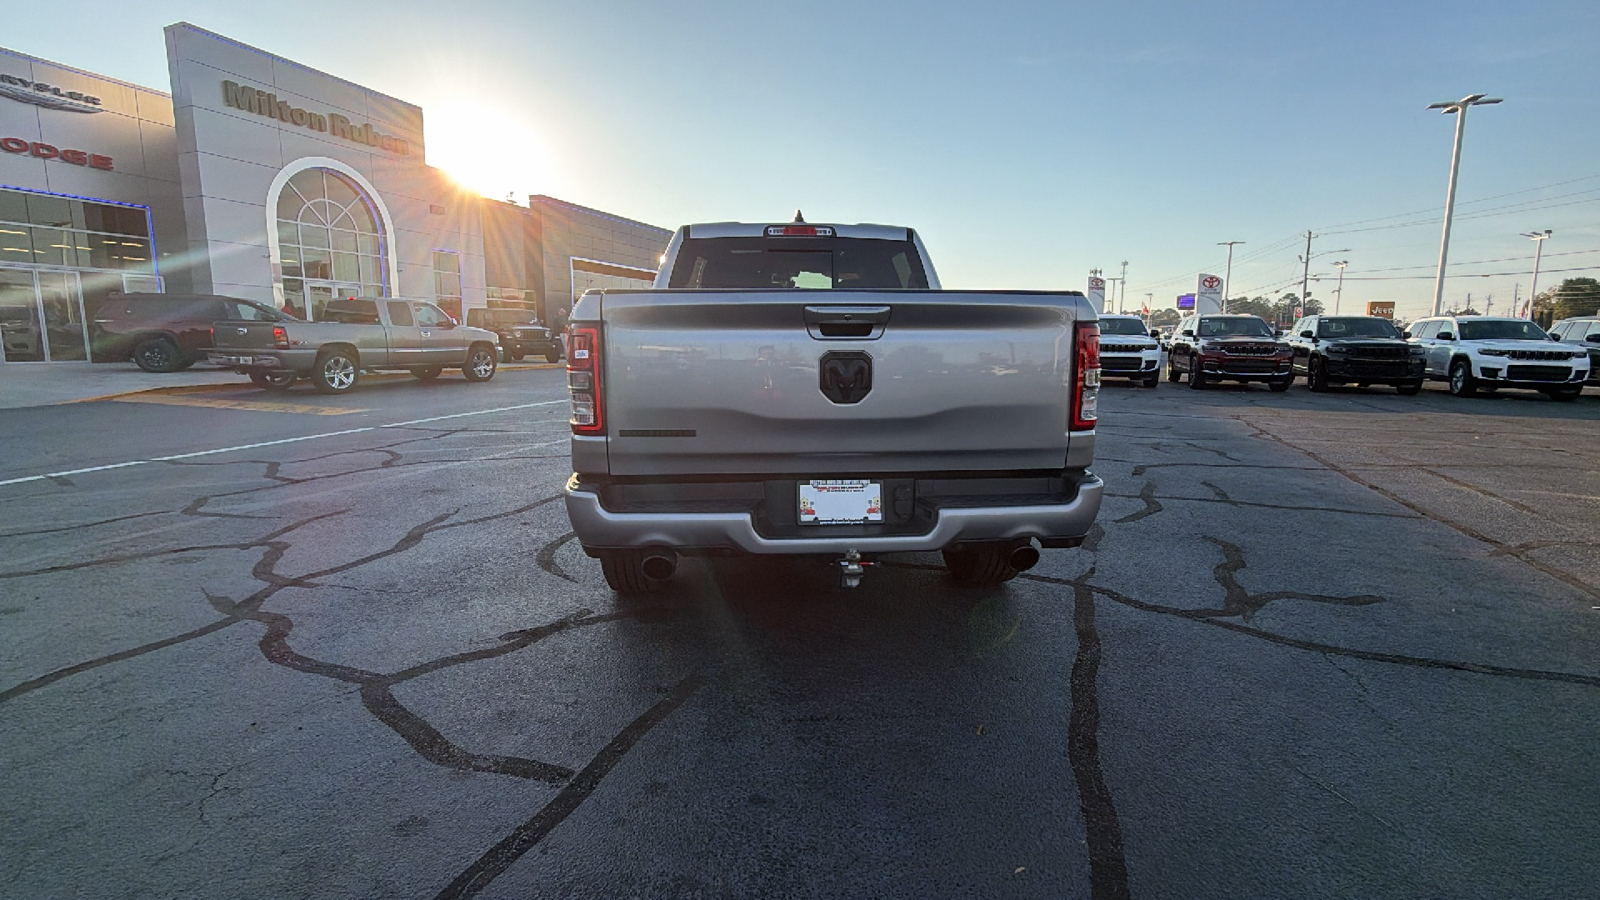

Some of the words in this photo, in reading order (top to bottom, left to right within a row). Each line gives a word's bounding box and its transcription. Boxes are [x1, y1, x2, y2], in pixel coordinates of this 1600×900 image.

[222, 80, 328, 132] Milton
[328, 112, 409, 155] Ruben
[1371, 306, 1394, 315] Jeep
